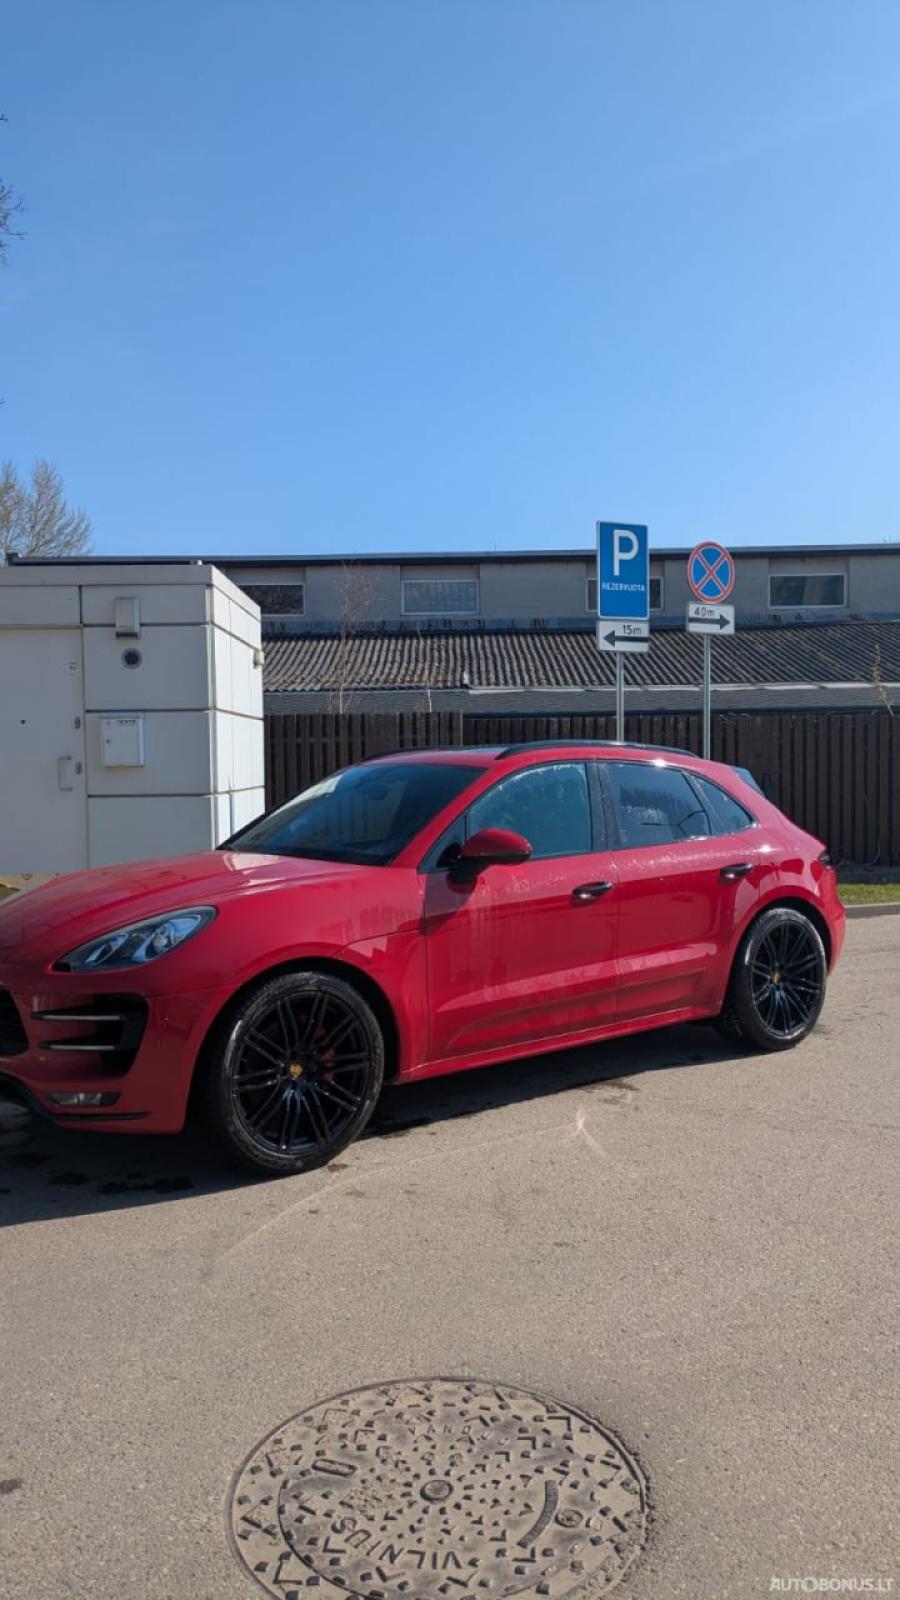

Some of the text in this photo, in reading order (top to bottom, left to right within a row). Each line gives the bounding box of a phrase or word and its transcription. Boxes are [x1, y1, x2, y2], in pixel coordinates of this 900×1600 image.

[613, 529, 639, 576] P
[602, 582, 645, 592] REZERVUOTA
[694, 606, 715, 617] 40m
[622, 625, 642, 636] 15m
[331, 1517, 462, 1570] VILNIUS
